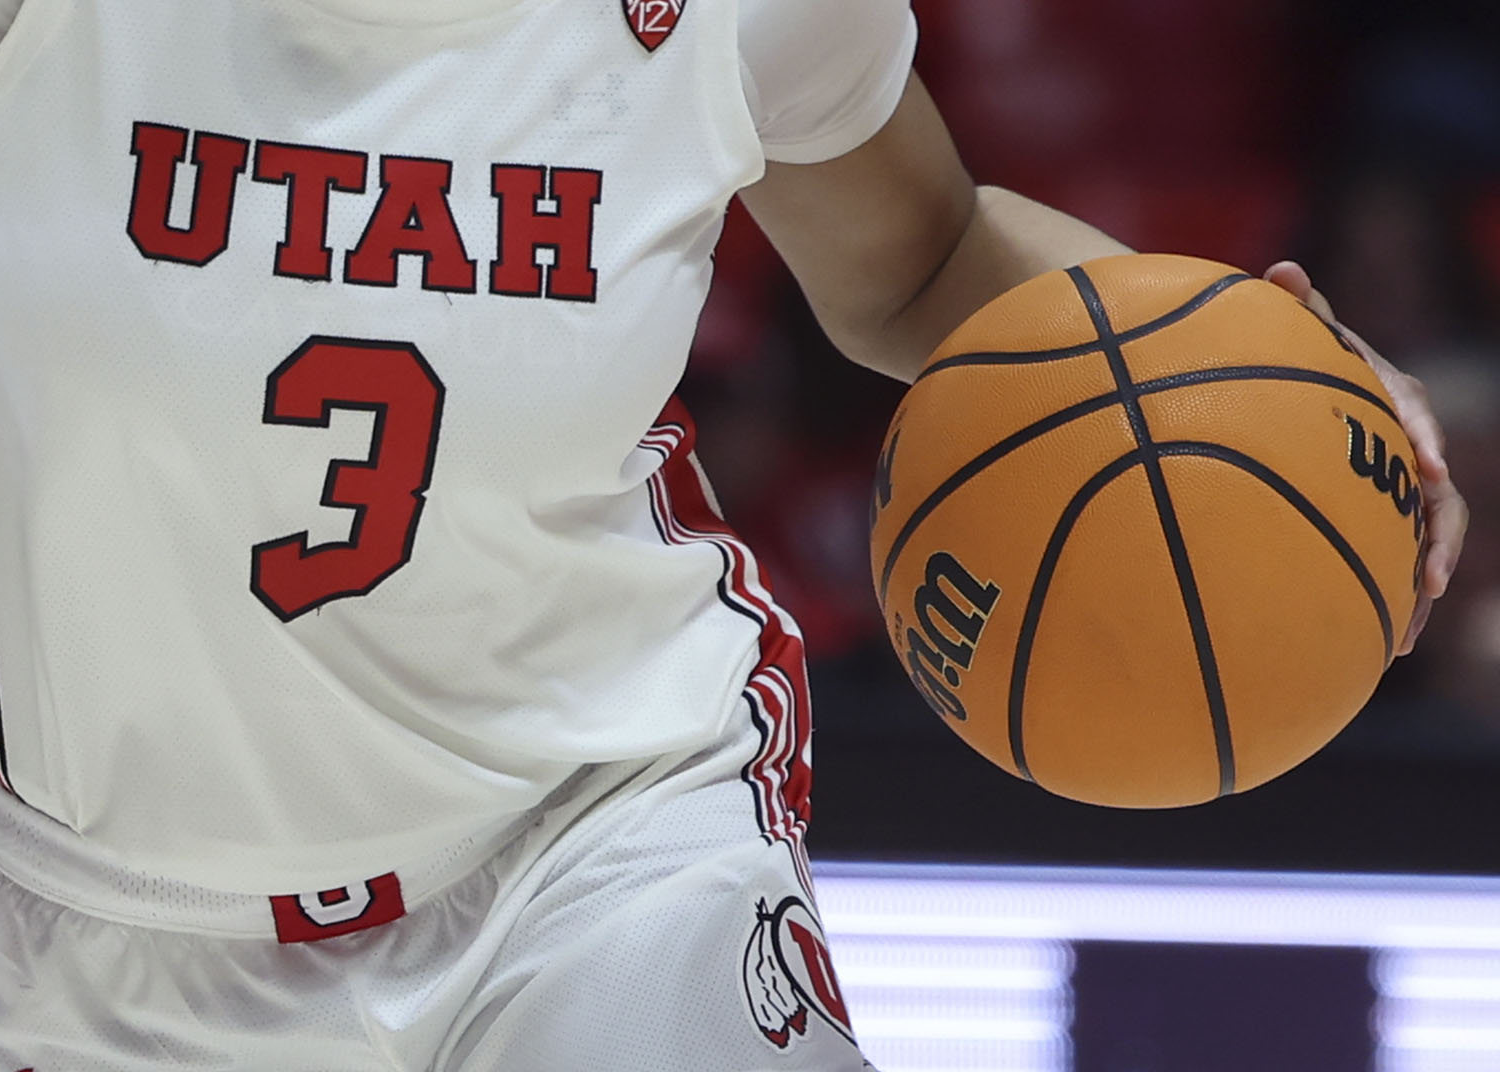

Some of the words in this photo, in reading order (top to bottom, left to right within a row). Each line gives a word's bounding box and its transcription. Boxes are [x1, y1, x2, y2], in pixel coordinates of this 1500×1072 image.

[638, 0, 670, 32] 12
[126, 121, 603, 303] UTAH
[250, 334, 446, 623] 3
